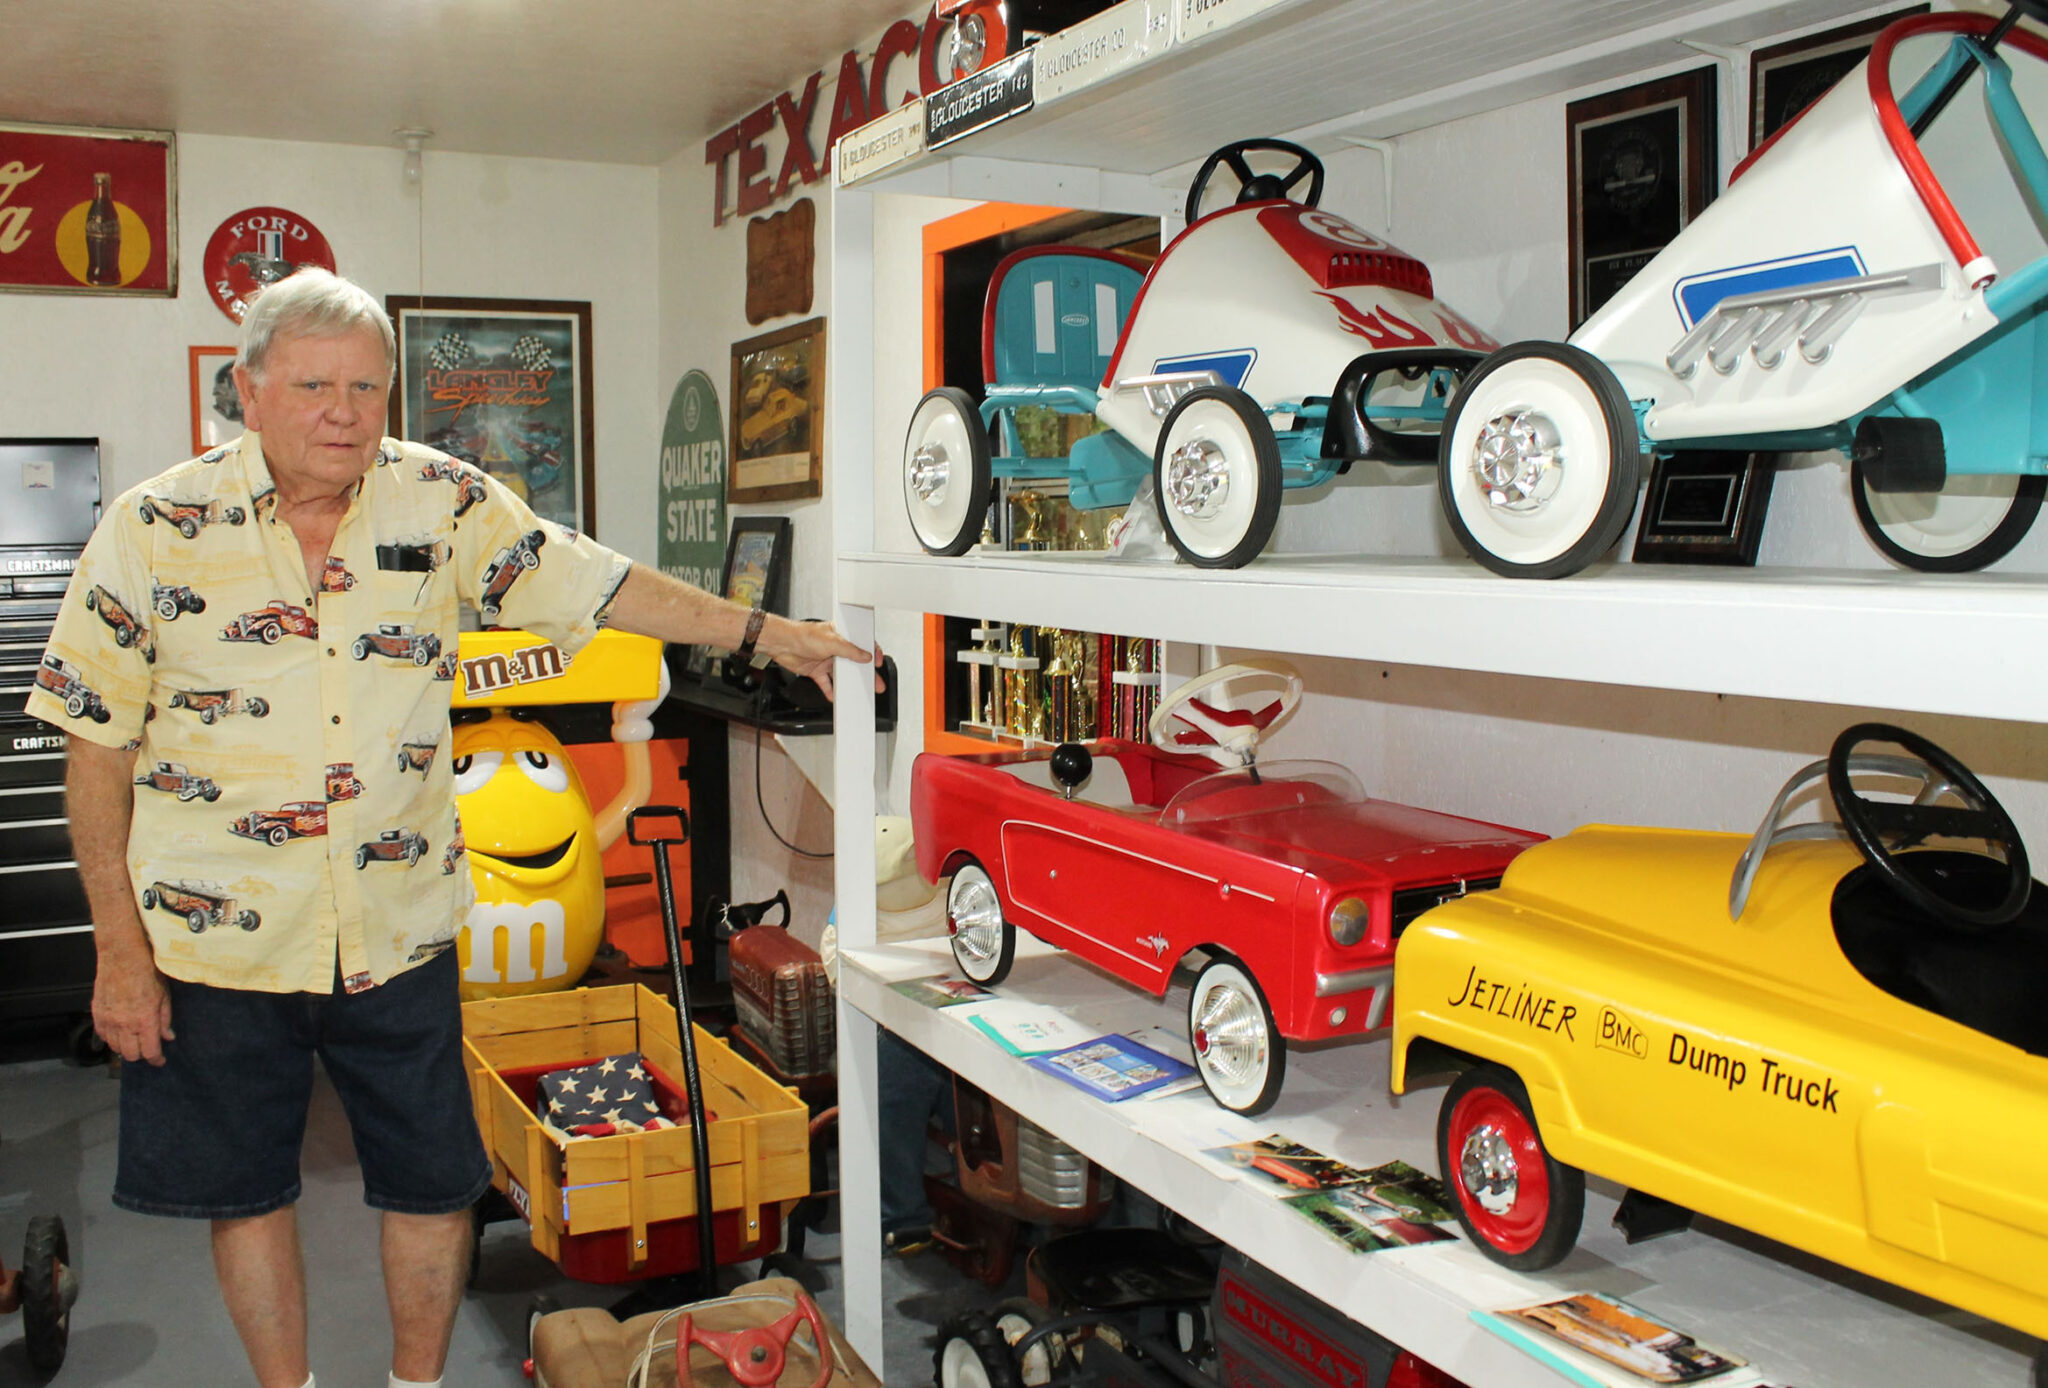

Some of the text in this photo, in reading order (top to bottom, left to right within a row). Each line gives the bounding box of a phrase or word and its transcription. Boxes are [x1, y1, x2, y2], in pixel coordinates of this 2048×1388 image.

[1047, 34, 1109, 79] GLOUCESTER
[936, 79, 1006, 128] GLOUCESTER
[849, 125, 904, 166] GLOUCESTER
[230, 216, 309, 241] FORD
[427, 370, 554, 393] LANGLEY
[662, 440, 722, 493] QUAKER
[667, 499, 717, 543] STATE
[1601, 1011, 1643, 1056] BMC
[1668, 1033, 1747, 1091] Dump
[1761, 1057, 1840, 1114] Truck
[1226, 1288, 1361, 1388] MURRAY
